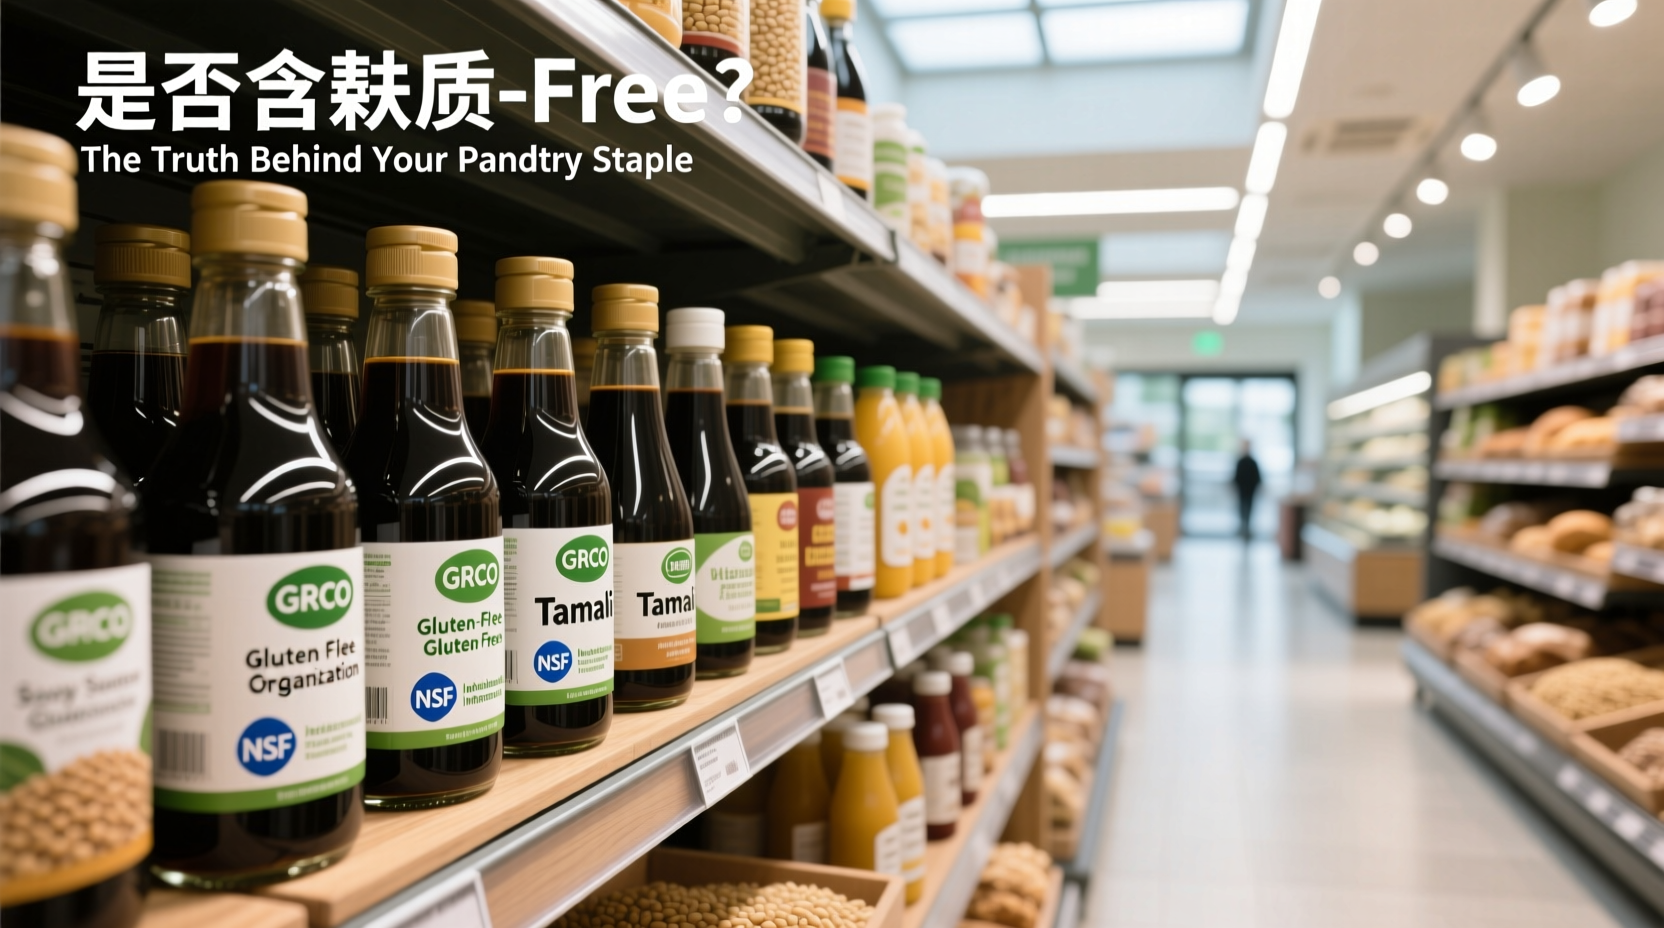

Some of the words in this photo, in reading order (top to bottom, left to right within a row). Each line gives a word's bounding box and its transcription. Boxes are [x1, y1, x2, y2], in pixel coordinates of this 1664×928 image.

[561, 546, 609, 570] GRCO
[442, 562, 498, 590] GRCO
[274, 579, 351, 614] GRCO
[245, 647, 320, 669] Gluten
[423, 638, 479, 656] Gluten
[537, 652, 570, 672] NSF
[415, 686, 454, 709] NSF
[241, 732, 293, 763] NSF
